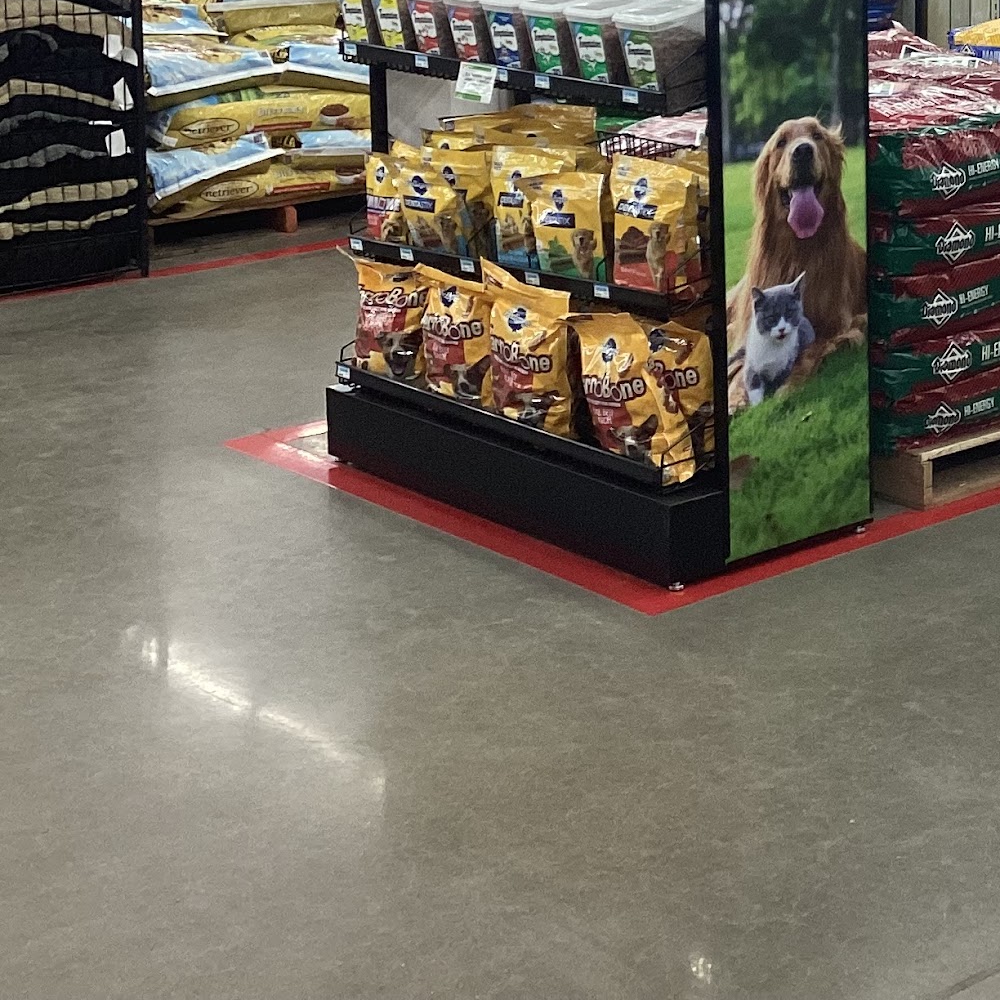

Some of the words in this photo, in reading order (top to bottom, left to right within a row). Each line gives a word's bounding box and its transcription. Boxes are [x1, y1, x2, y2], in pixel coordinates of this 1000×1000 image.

[967, 158, 1000, 177] HI-ENERGY
[937, 238, 974, 253] Diamond
[958, 284, 989, 305] HI-ENERGY
[922, 298, 957, 317] Diamond
[932, 353, 972, 373] Diamond
[963, 397, 995, 417] HI-ENERGY
